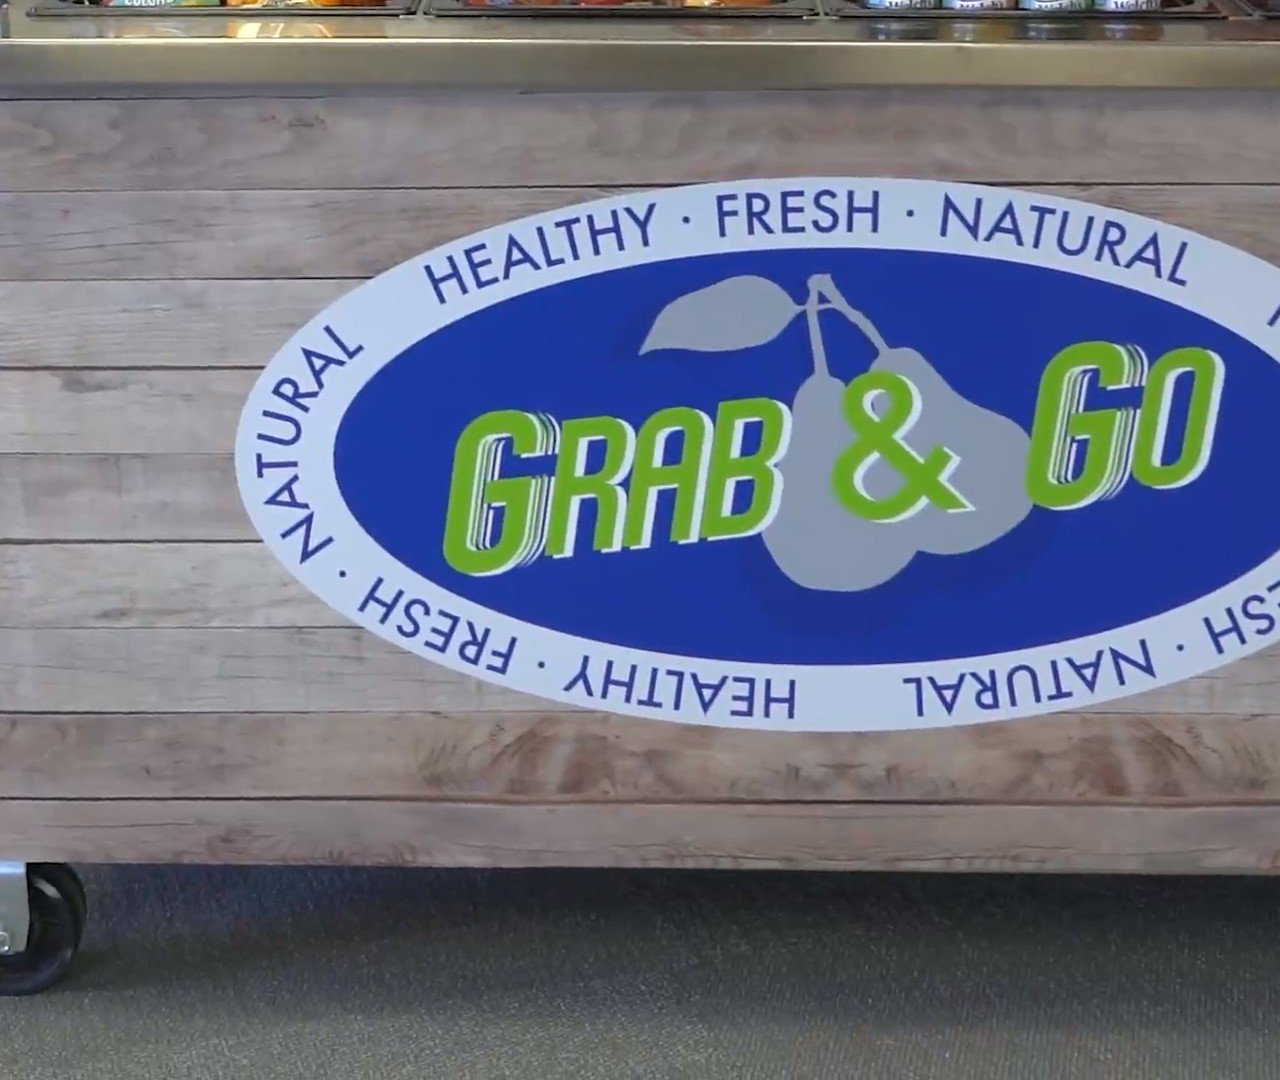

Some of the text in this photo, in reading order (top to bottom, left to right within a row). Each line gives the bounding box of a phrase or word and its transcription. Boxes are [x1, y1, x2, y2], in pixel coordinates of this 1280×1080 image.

[423, 189, 1188, 305] HEALTHY FRESH NATURAL
[256, 325, 797, 719] HEALTHY FRESH NATURAL
[442, 340, 1226, 577] GRAB & GO
[903, 638, 1157, 717] NATURAL
